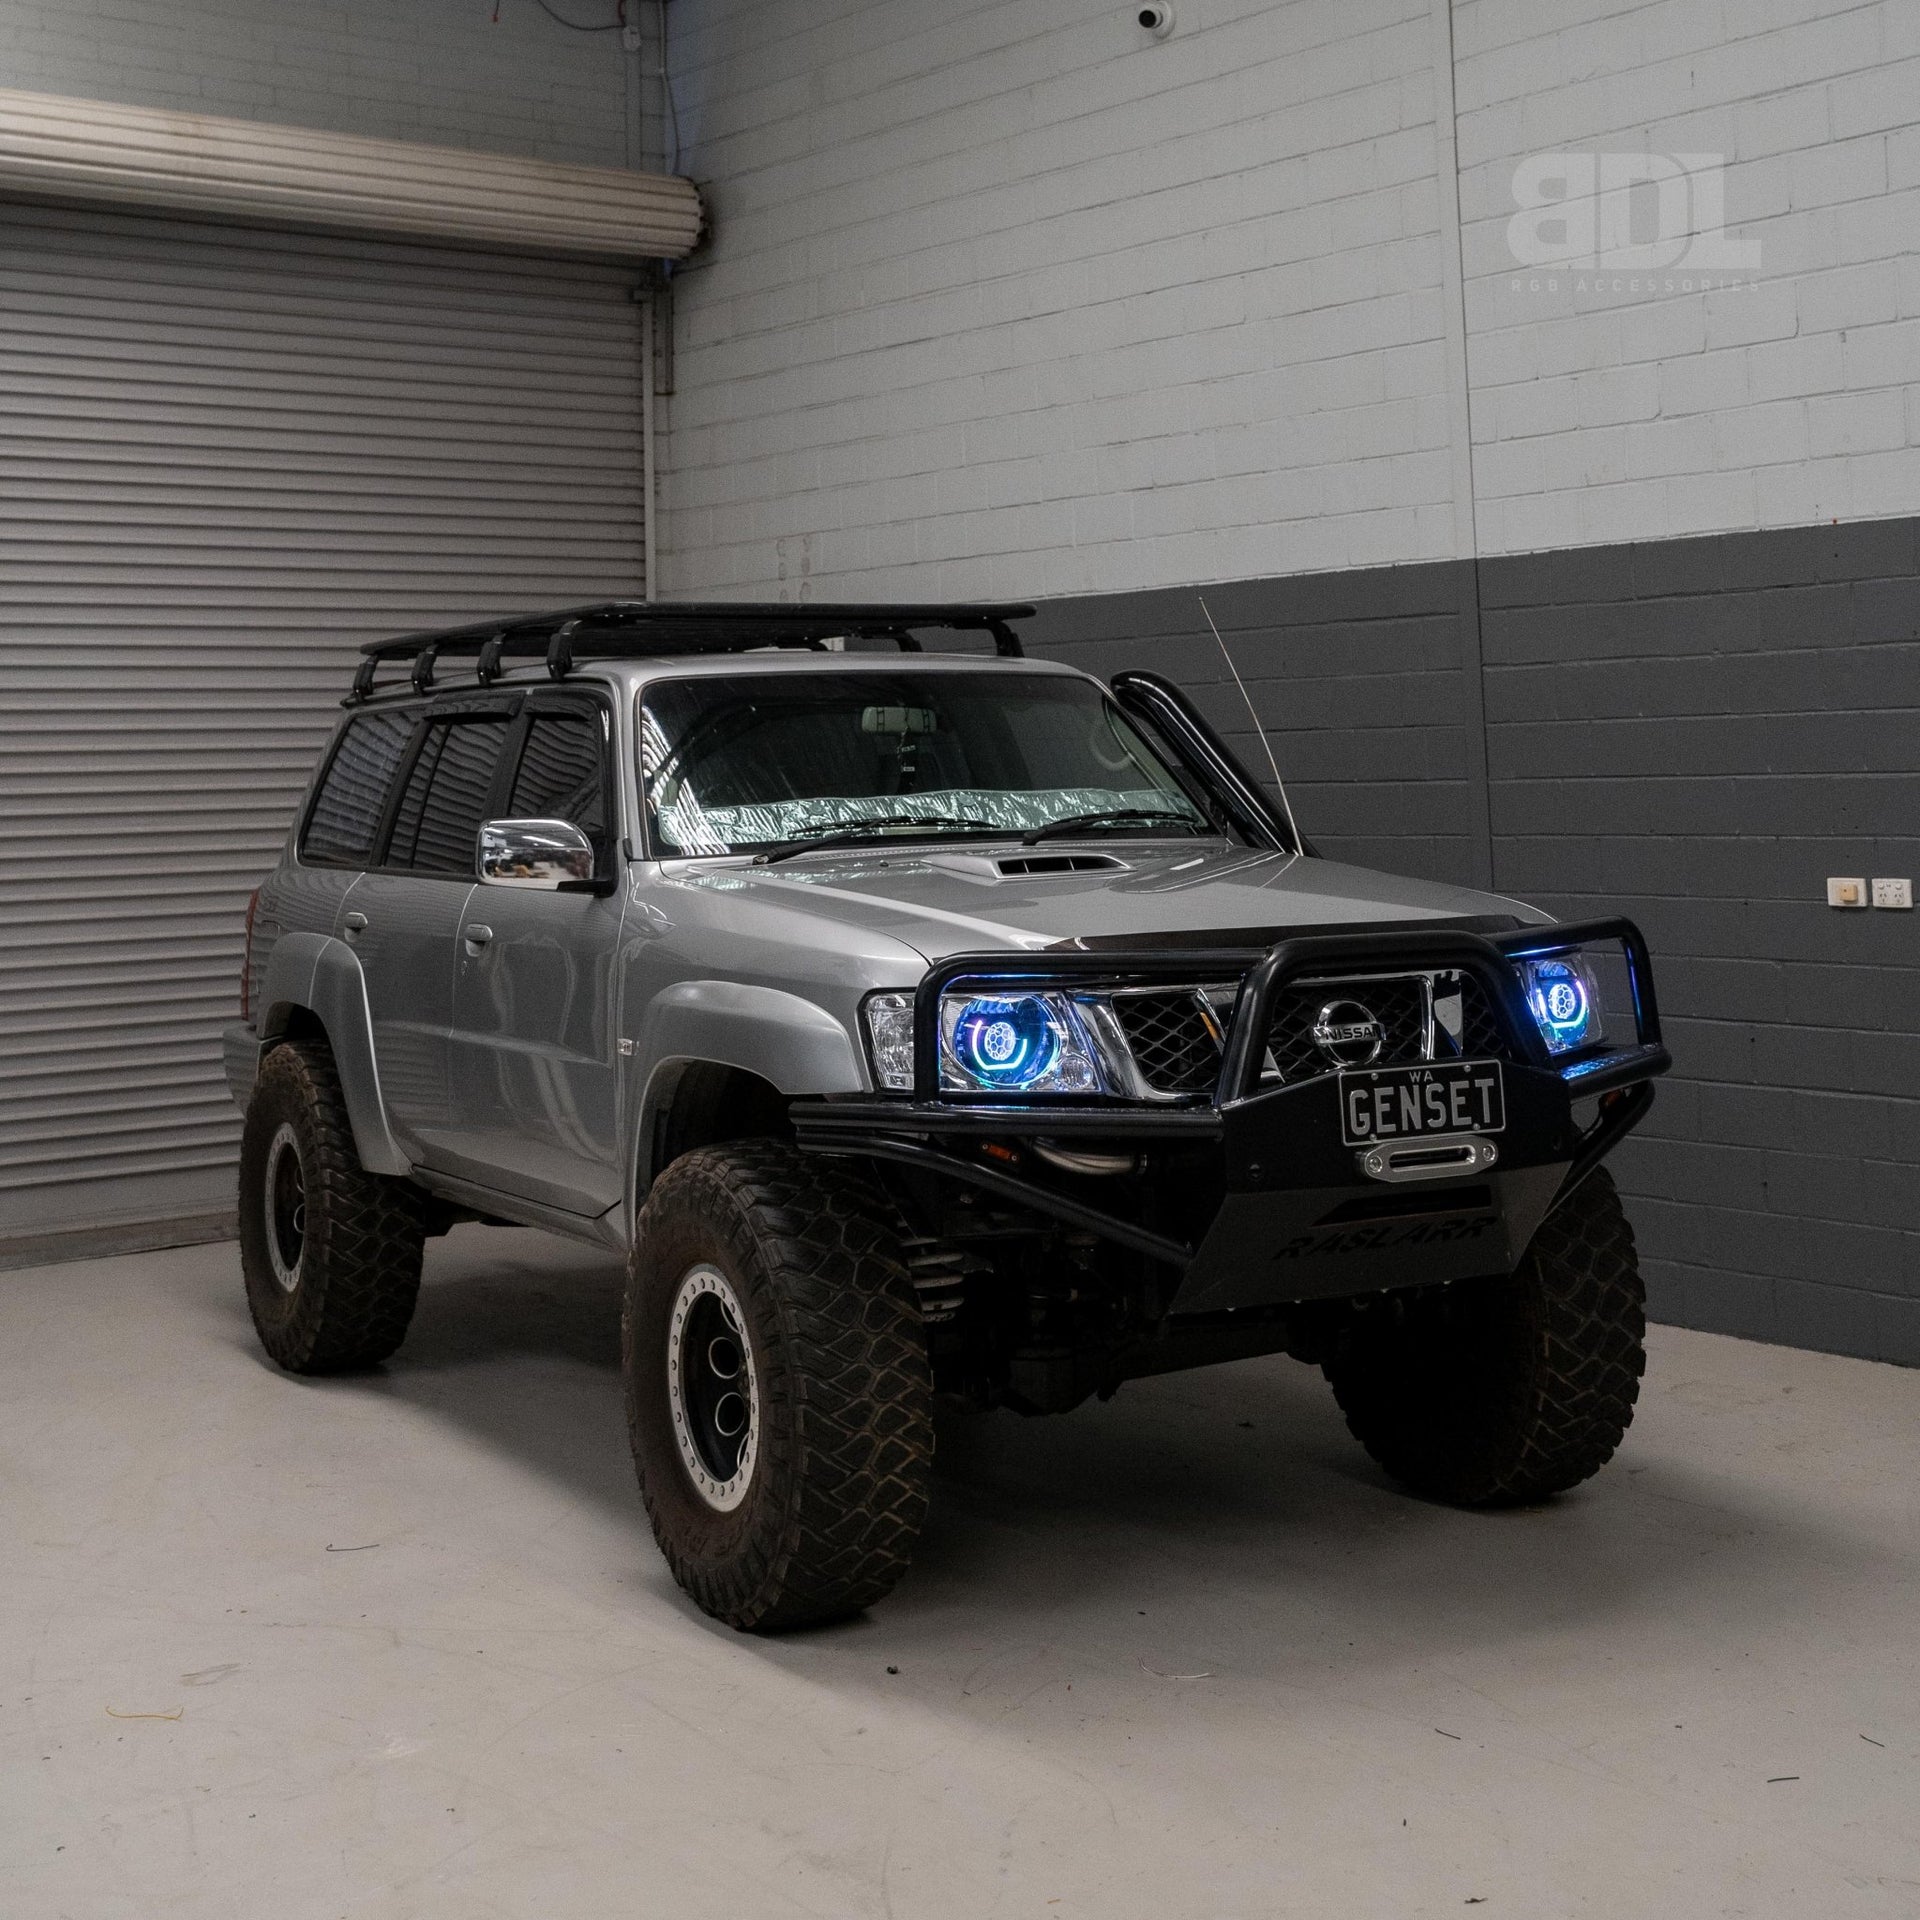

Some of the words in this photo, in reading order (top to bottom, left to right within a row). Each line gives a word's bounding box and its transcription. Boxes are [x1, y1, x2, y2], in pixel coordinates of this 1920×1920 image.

[1409, 1070, 1434, 1083] WA
[1350, 1078, 1495, 1135] GENSET
[1272, 1216, 1498, 1260] RASLARR
